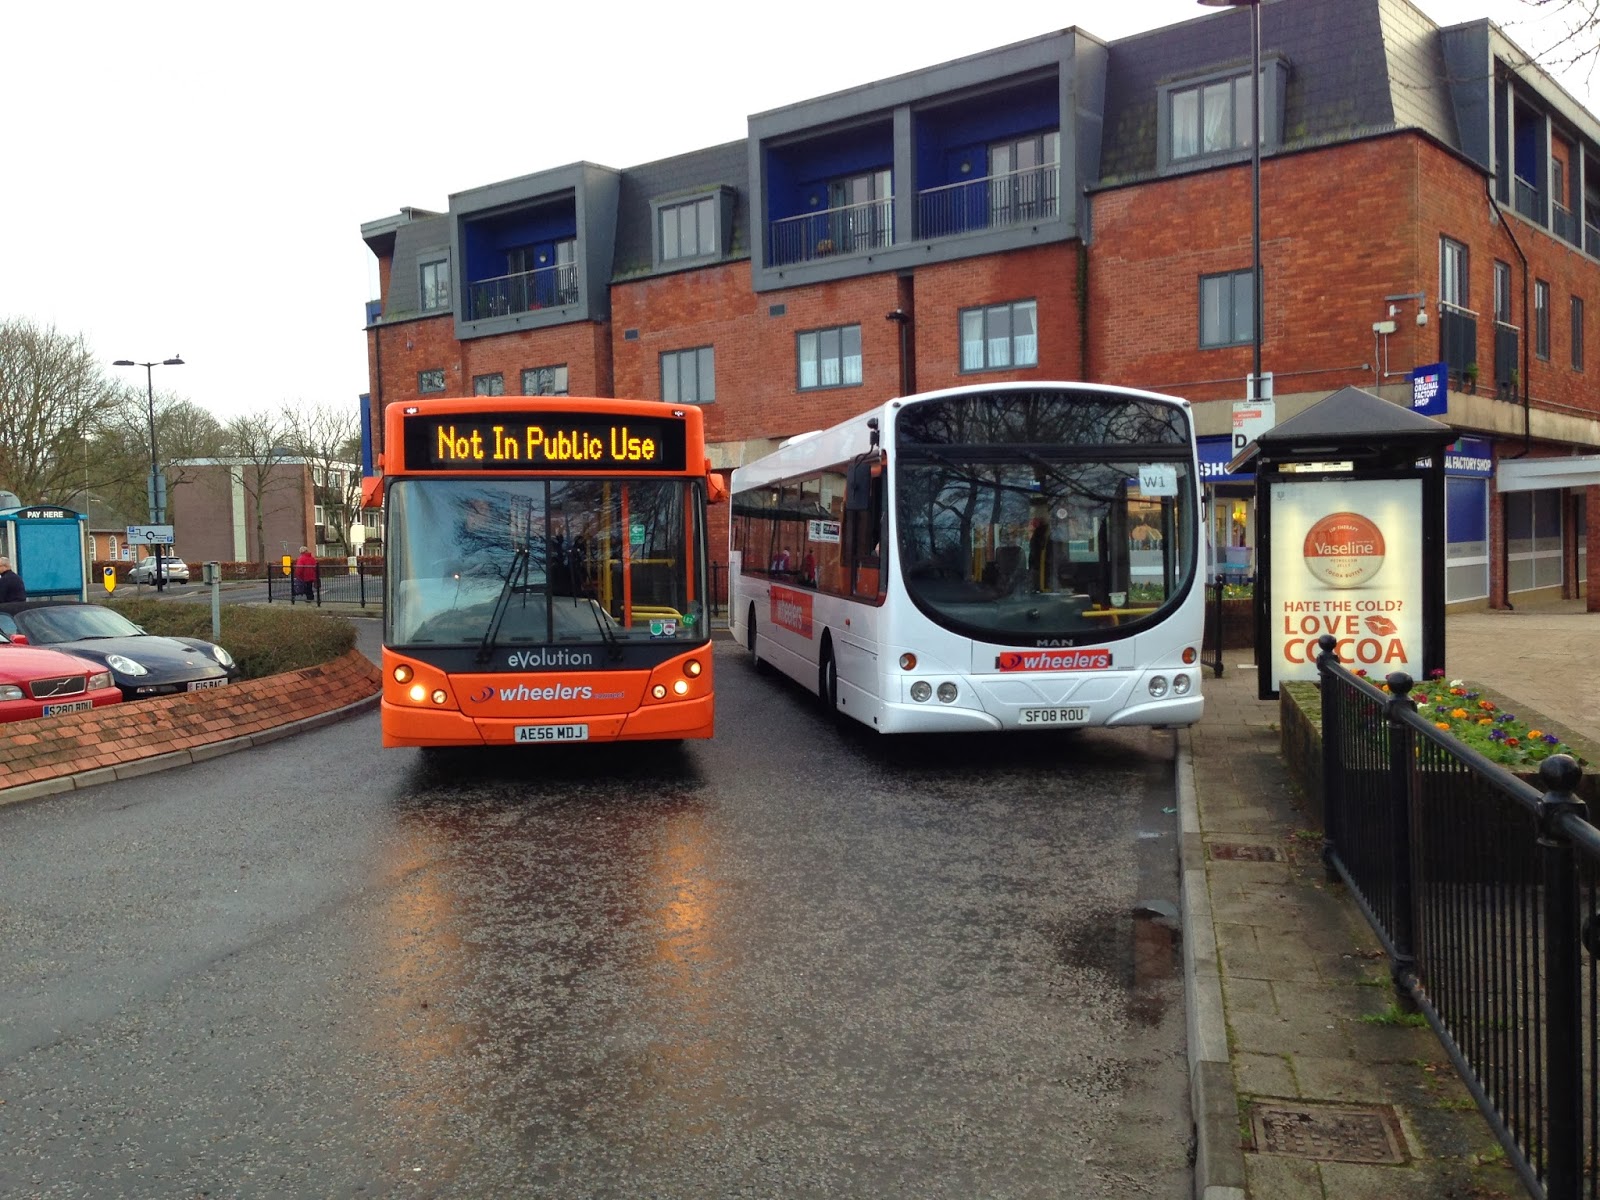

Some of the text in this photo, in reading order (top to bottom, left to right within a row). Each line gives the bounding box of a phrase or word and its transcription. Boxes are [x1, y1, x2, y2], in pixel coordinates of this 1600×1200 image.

[1414, 376, 1424, 385] THE
[1414, 382, 1438, 392] ORIGINAL
[1414, 389, 1437, 399] FACTORY
[1414, 398, 1429, 407] SHOP
[438, 426, 655, 460] Not In Public Use
[1235, 434, 1247, 448] D
[1452, 456, 1477, 470] FACTORY
[1476, 458, 1491, 472] SHOP
[1143, 476, 1166, 488] W1
[1315, 541, 1373, 555] Vaseline
[1284, 600, 1403, 612] HATE THE COLD?
[1284, 615, 1360, 635] LOVE
[1036, 639, 1074, 647] MAN
[508, 647, 593, 669] eVolution
[1023, 652, 1108, 668] wheelers
[500, 683, 593, 701] wheelers
[1025, 709, 1084, 722] SF08 ROU
[520, 726, 583, 740] AE56 MDJ
